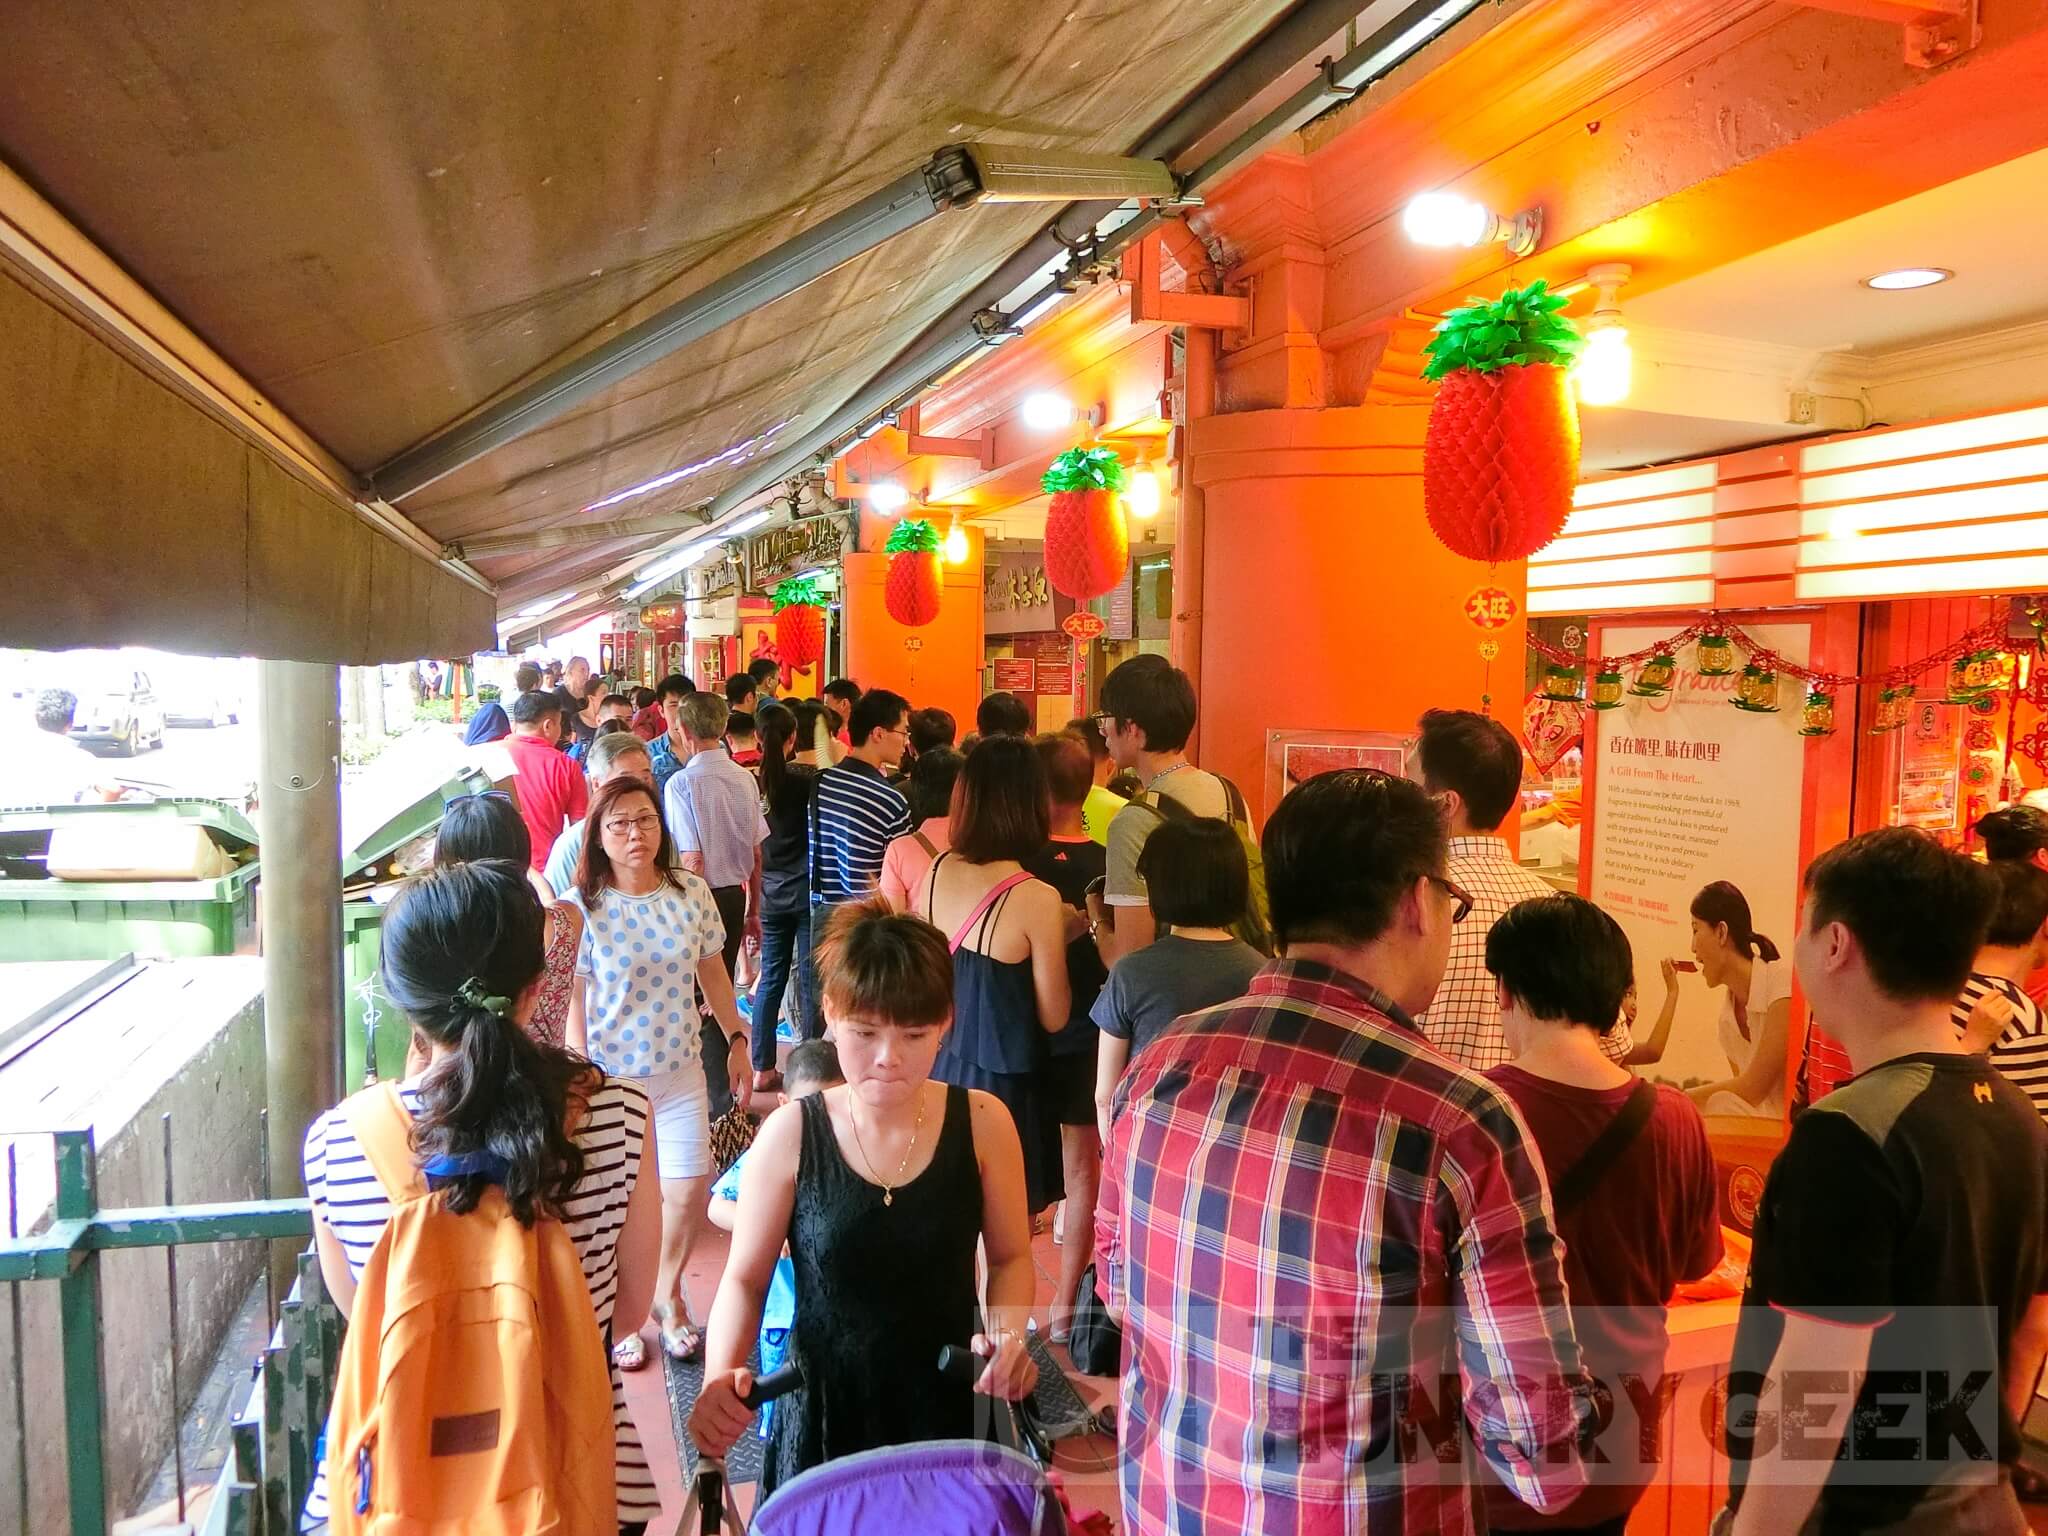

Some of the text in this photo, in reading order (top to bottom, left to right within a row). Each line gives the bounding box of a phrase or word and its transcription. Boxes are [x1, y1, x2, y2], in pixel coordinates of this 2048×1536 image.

[1469, 593, 1512, 621] 大旺
[1068, 618, 1099, 633] 大旺
[1609, 766, 1615, 775] A
[1617, 767, 1631, 777] Gift
[1634, 768, 1653, 779] From
[1655, 770, 1669, 780] The
[1672, 792, 1682, 800] that
[1701, 796, 1713, 804] back
[1654, 816, 1667, 824] Each
[1699, 823, 1728, 833] produced
